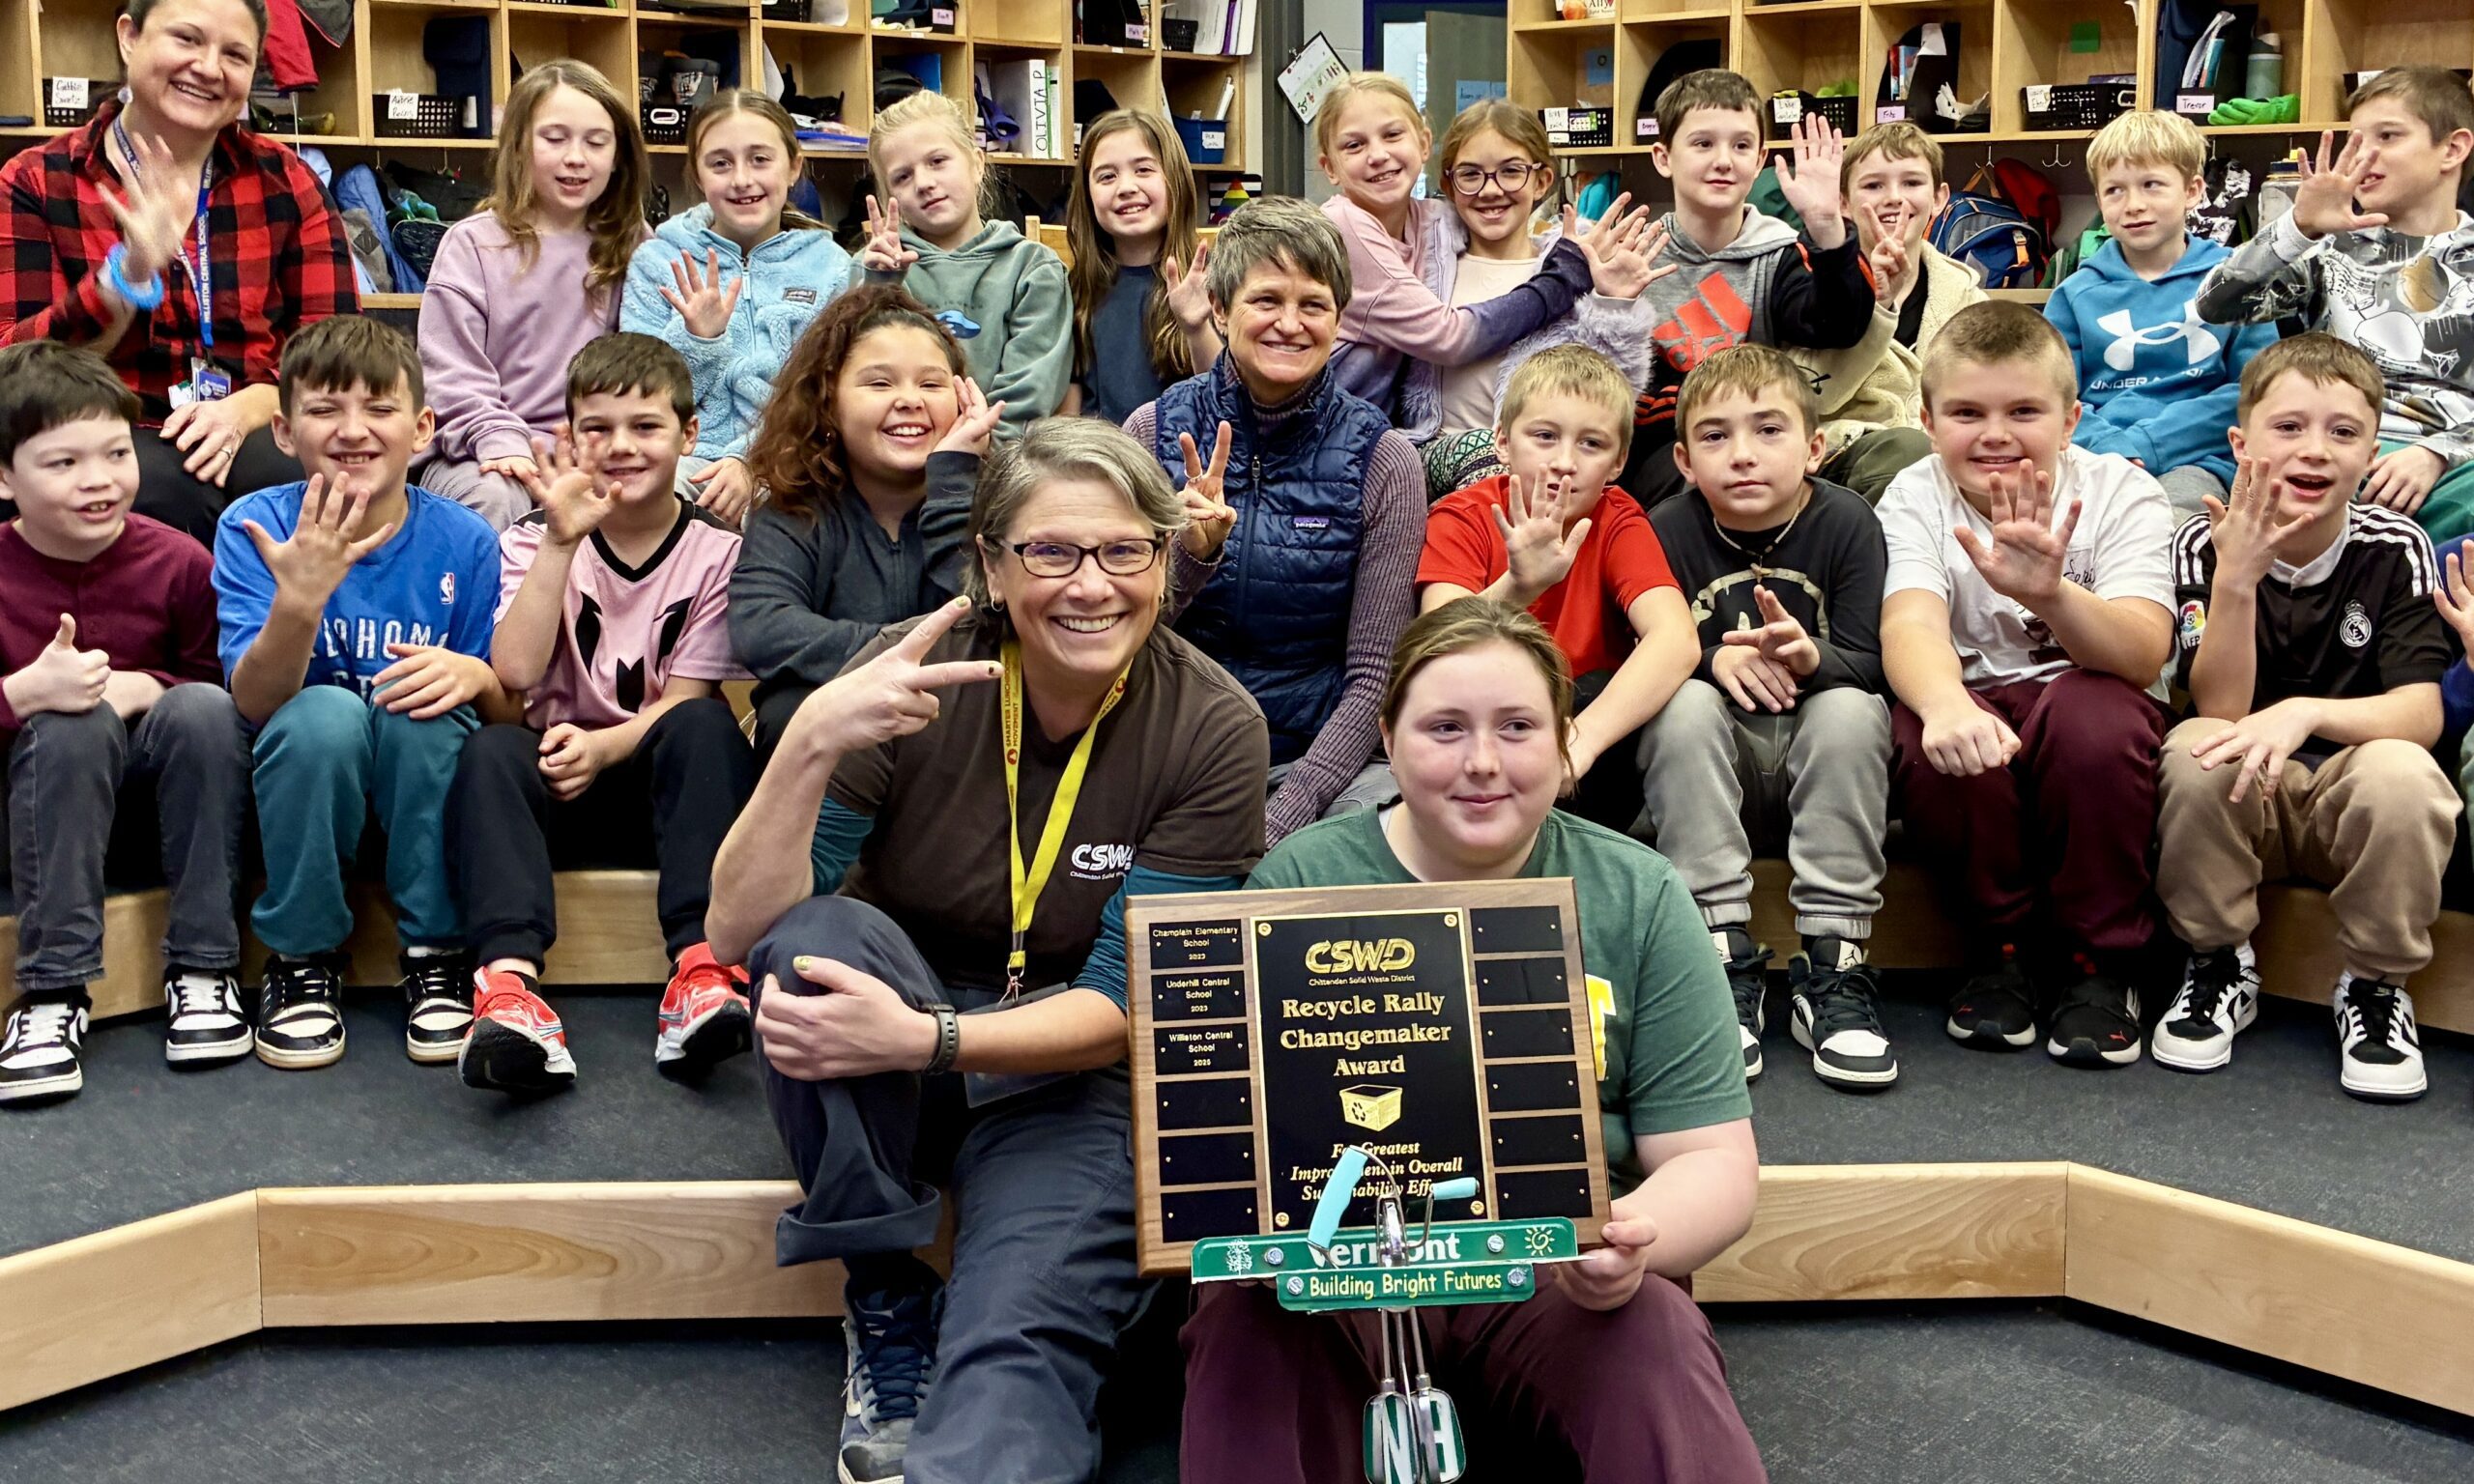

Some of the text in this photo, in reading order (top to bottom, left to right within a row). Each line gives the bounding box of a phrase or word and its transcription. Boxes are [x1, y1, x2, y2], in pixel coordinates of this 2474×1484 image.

[1032, 70, 1049, 151] OLIVIA P
[197, 214, 212, 324] WILLISTON CENTRAL SCHOOL
[2090, 377, 2147, 389] UNDER
[310, 617, 449, 660] LAHOM
[1152, 927, 1239, 937] Champlain Elementary
[1183, 938, 1210, 948] School
[1305, 937, 1416, 974] CSWD
[1165, 977, 1230, 988] Underhill Central
[1309, 974, 1416, 986] Chittenden Solid Waste District
[1185, 989, 1213, 999] School
[1282, 992, 1446, 1020] Recycle Rally
[1168, 1030, 1233, 1042] Williston Central
[1280, 1022, 1452, 1050] Changemaker
[1188, 1043, 1216, 1053] School
[1333, 1054, 1406, 1076] Award
[1361, 1141, 1420, 1156] Greatest
[1391, 1160, 1405, 1175] in
[1408, 1156, 1463, 1174] Overall
[1308, 1232, 1462, 1269] Veront
[1309, 1268, 1502, 1300] Building Bright Futures
